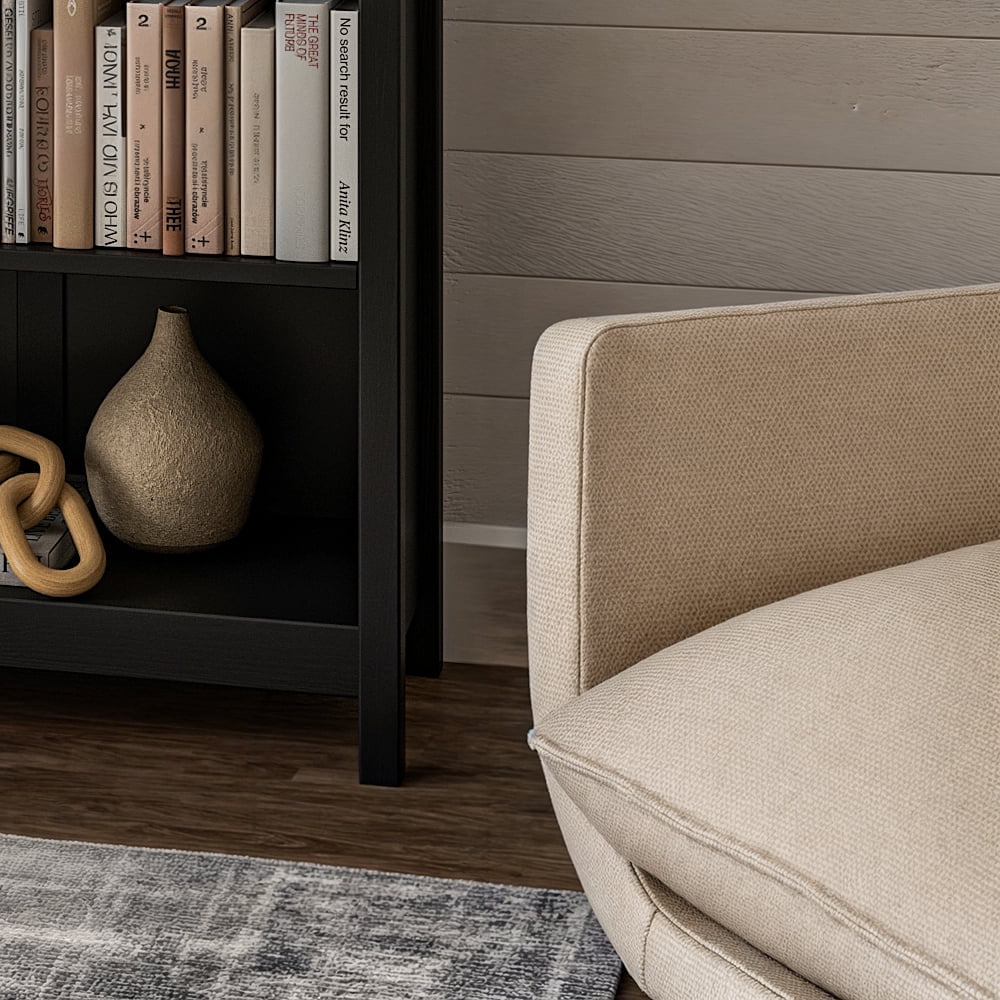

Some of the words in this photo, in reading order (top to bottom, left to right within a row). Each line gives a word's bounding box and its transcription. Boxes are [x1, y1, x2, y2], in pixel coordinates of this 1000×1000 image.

[138, 14, 149, 27] 2
[196, 17, 207, 31] 2
[296, 13, 307, 46] MINDS
[308, 14, 319, 34] THE
[339, 18, 351, 36] No
[296, 48, 307, 61] OF
[308, 35, 319, 69] GREAT
[339, 39, 351, 81] search
[339, 85, 351, 119] result
[339, 123, 351, 141] for
[338, 180, 352, 217] Anita
[104, 201, 118, 246] WHO
[338, 220, 352, 254] Klinz
